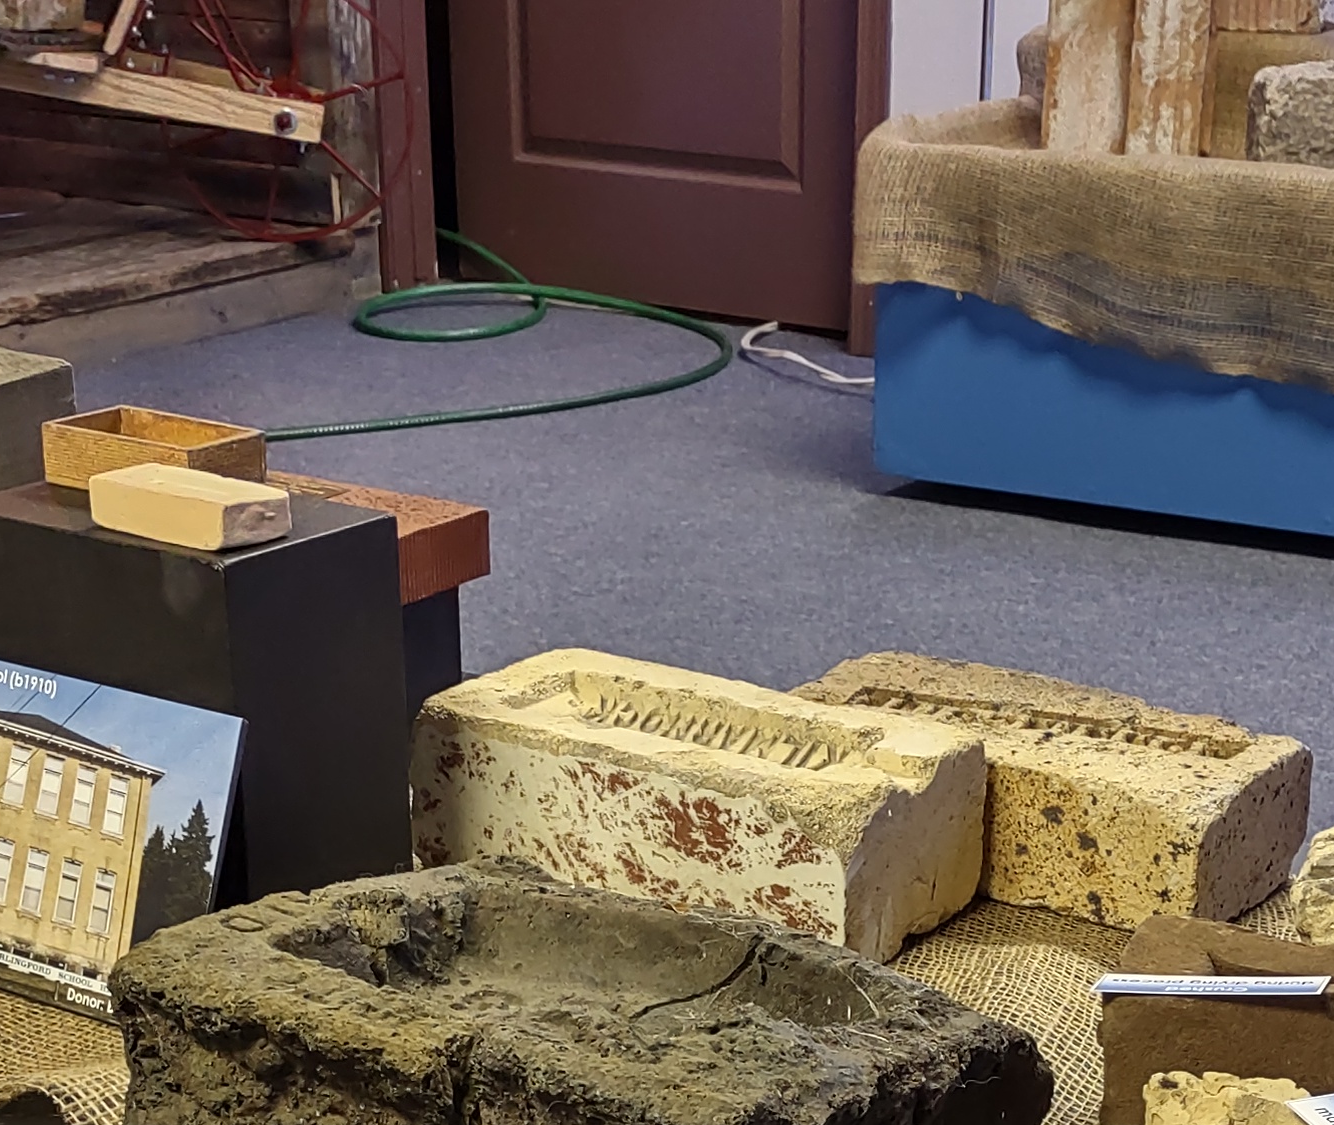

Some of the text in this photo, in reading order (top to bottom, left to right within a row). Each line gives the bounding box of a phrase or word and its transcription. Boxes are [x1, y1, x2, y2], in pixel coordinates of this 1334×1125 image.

[9, 672, 57, 698] (b1910)
[58, 972, 93, 988] SCHOOL
[67, 988, 105, 1011] Donor:
